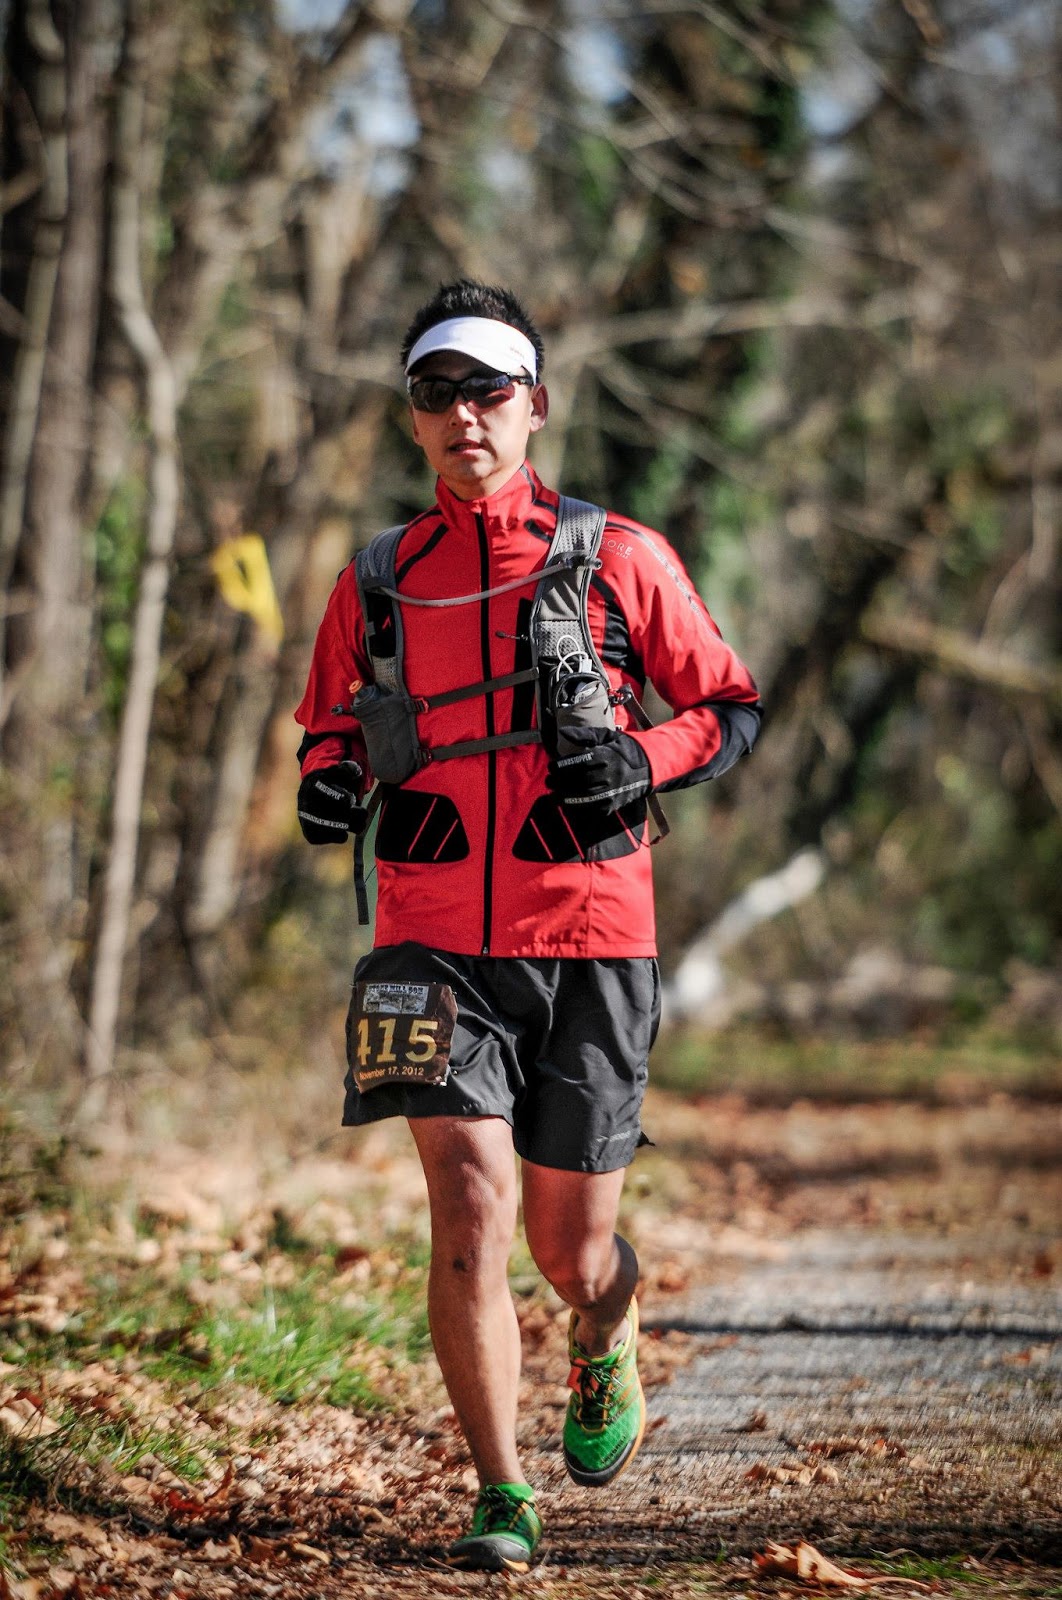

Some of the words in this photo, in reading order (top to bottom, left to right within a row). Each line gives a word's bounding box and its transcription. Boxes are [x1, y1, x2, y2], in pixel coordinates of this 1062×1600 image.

[359, 1068, 385, 1081] November
[388, 1066, 400, 1076] 17,
[402, 1066, 424, 1076] 2012
